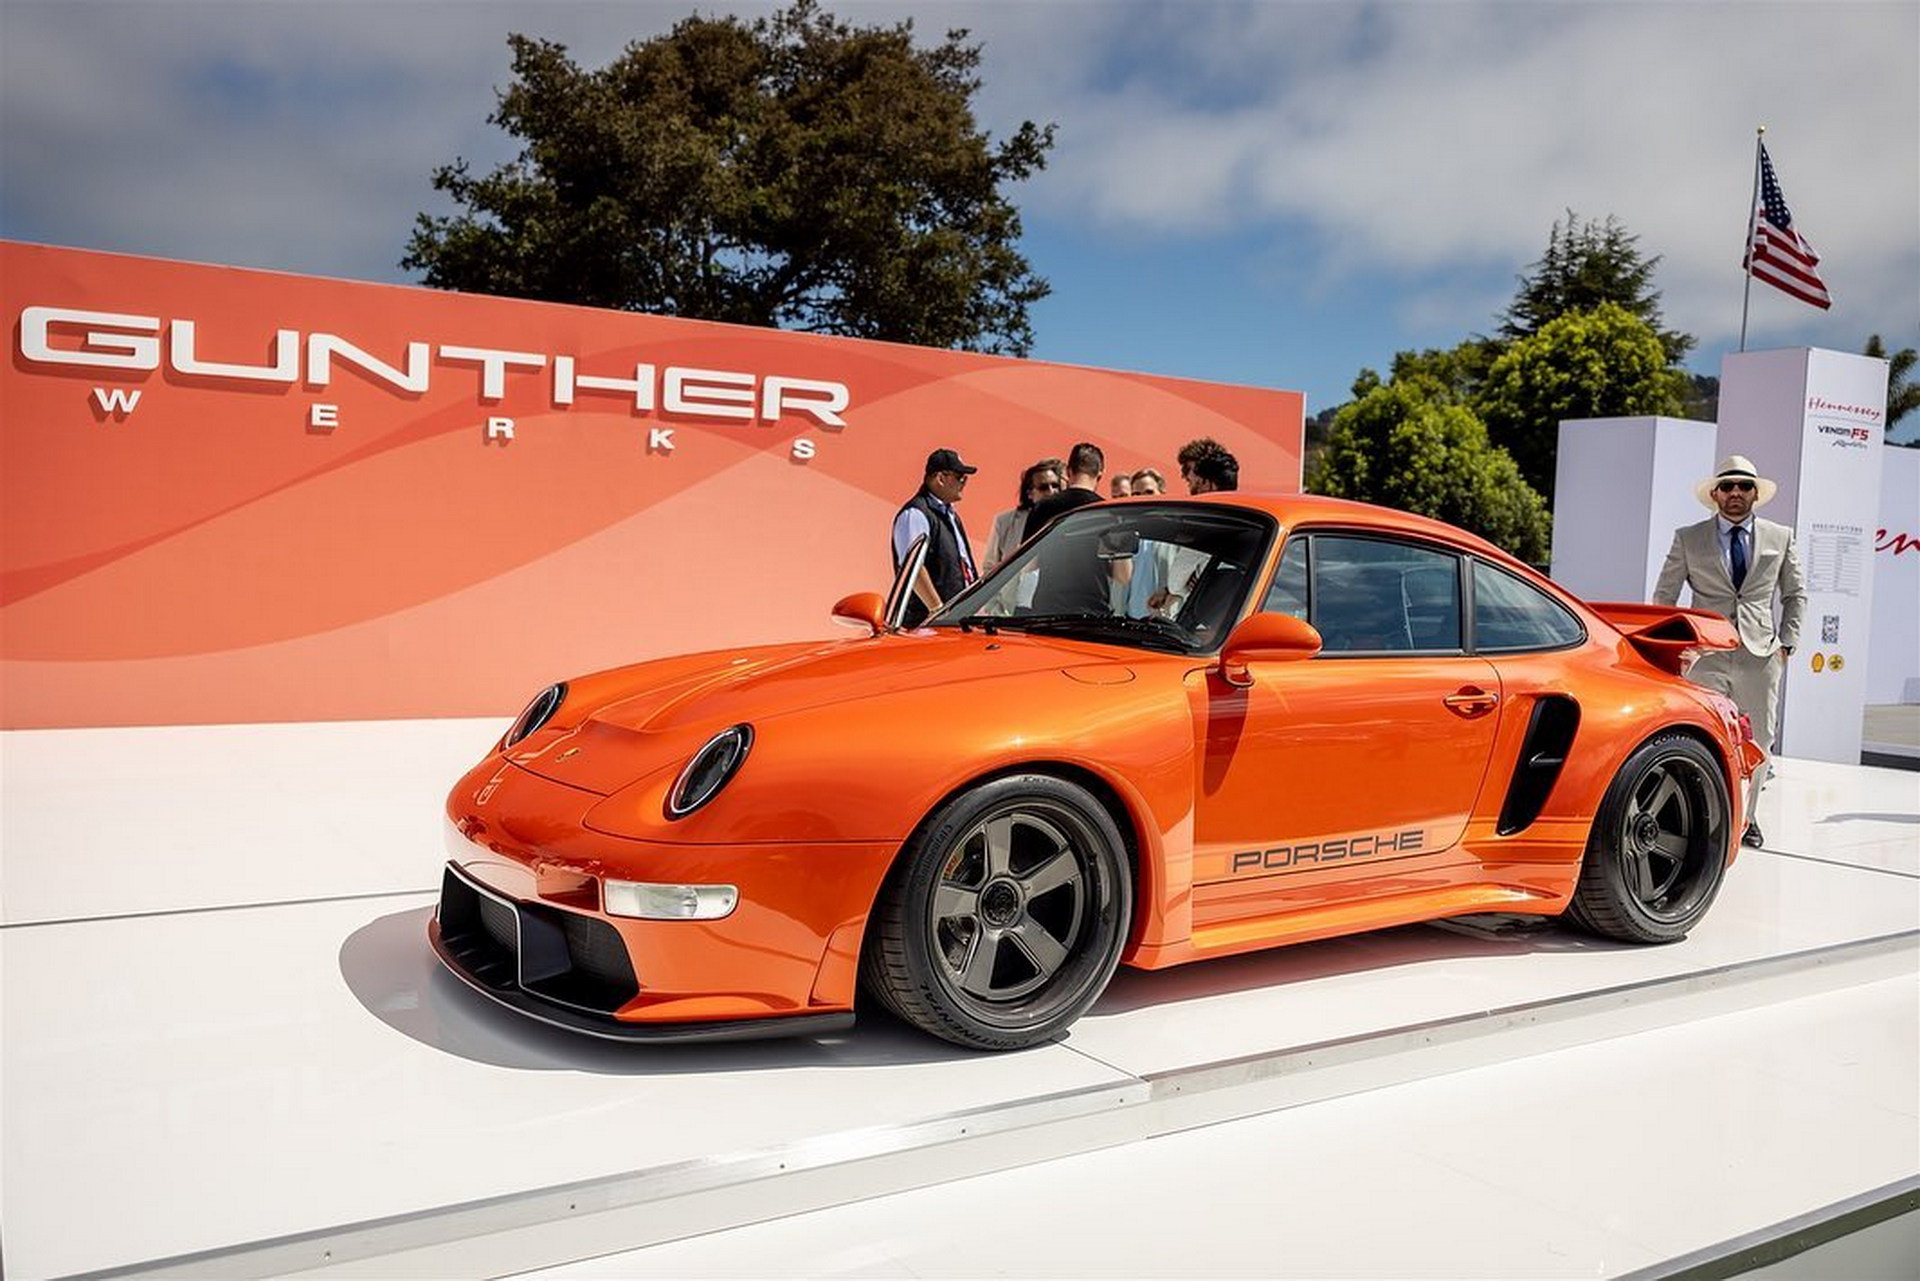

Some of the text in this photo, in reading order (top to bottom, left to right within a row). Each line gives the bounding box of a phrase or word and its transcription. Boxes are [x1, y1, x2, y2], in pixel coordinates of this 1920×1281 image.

[20, 306, 850, 427] GUNTHER
[1808, 397, 1880, 421] Hennessey
[1233, 830, 1424, 873] PORSCHE
